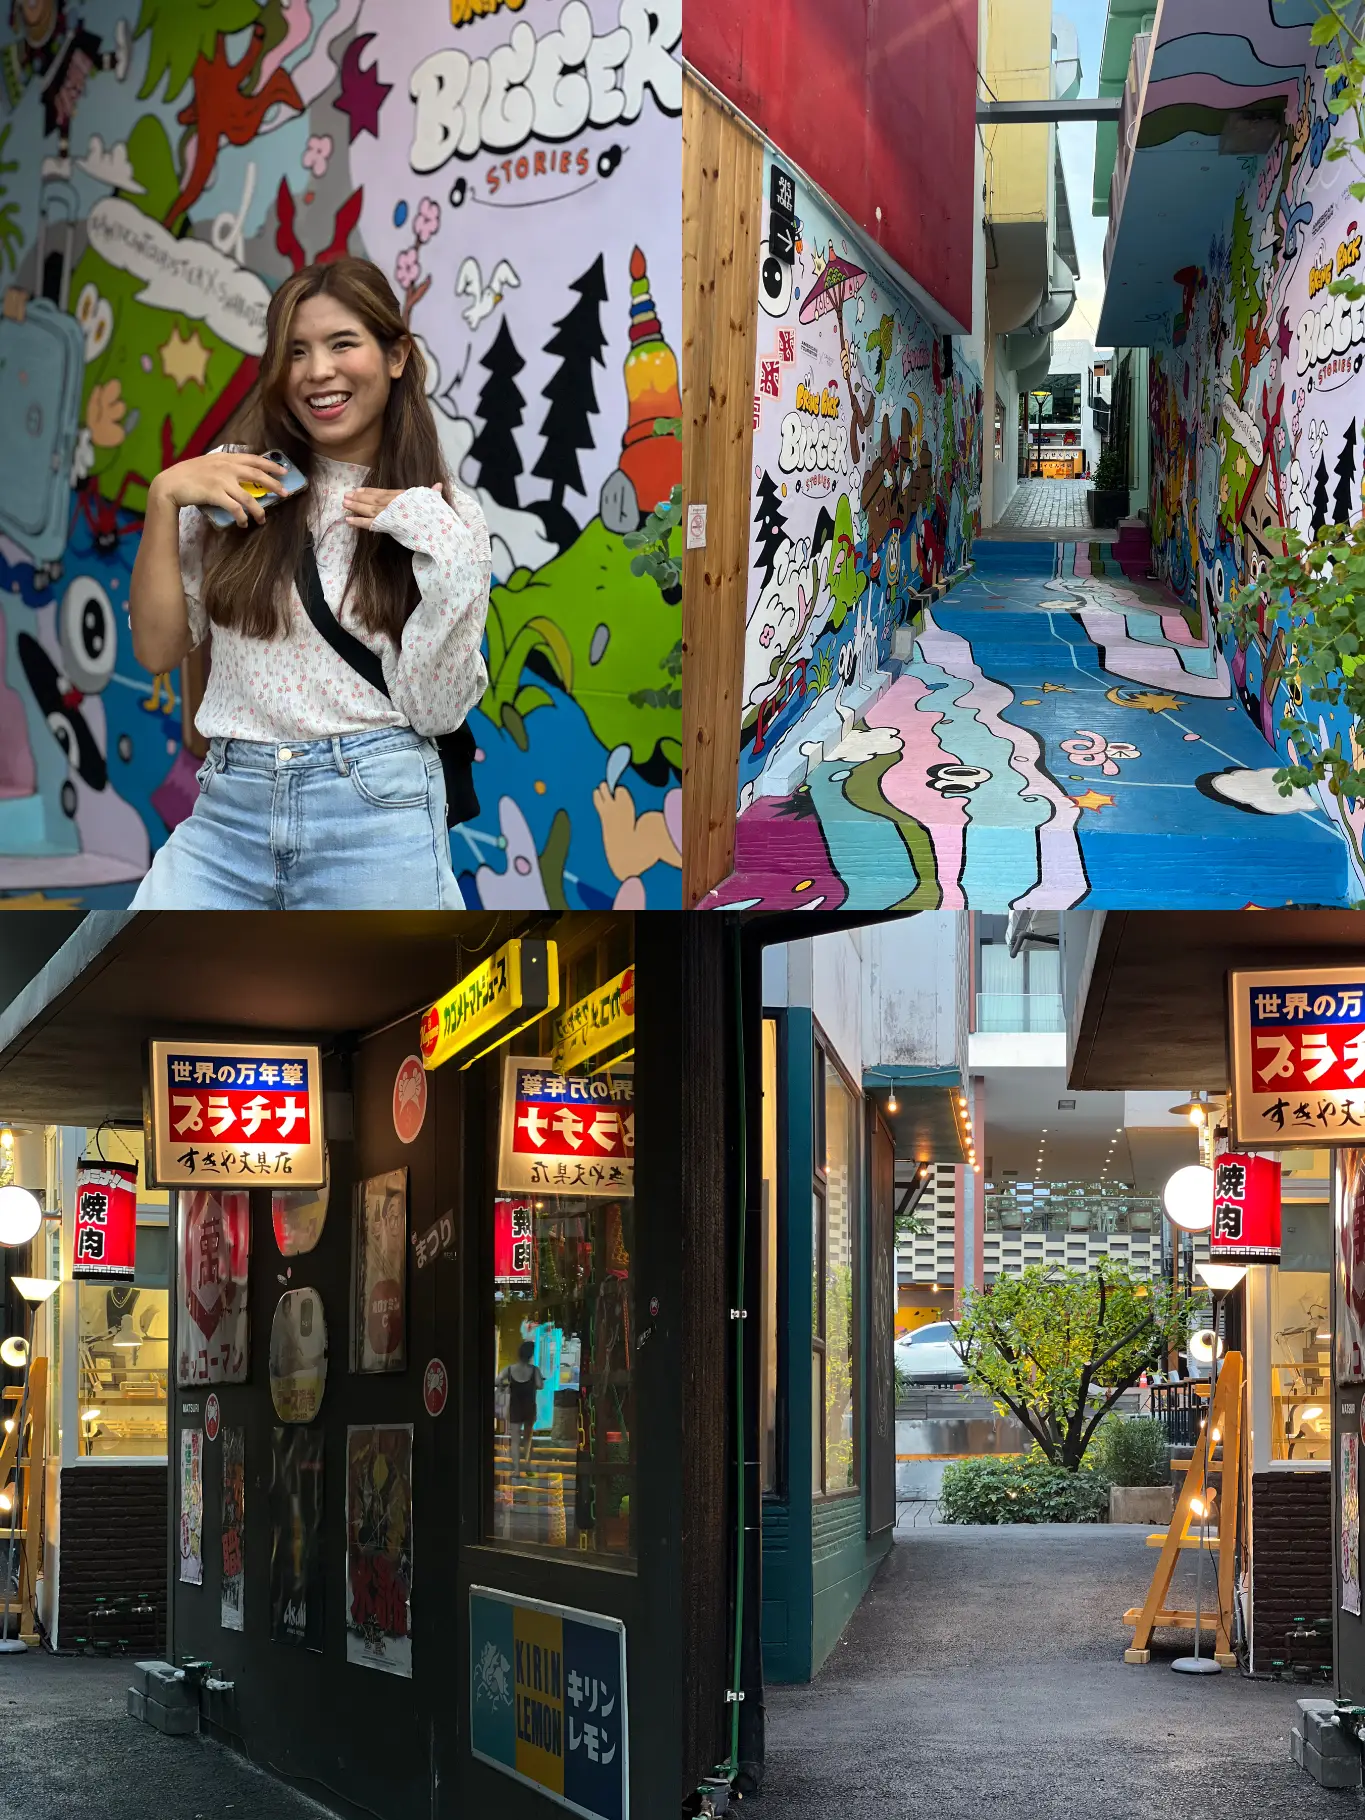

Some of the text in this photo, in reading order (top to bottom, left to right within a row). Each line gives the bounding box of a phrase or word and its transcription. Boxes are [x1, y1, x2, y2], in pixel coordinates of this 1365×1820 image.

[409, 0, 682, 174] BIGGER
[486, 147, 590, 195] STORIES
[776, 194, 793, 212] TOILET
[1308, 234, 1363, 299] BRING BACK
[1317, 356, 1351, 385] STORIES
[796, 382, 840, 420] BRING BACK
[778, 411, 848, 476] BIGGER
[805, 473, 831, 491] STORIES
[171, 1061, 304, 1086] 世界の万年筆
[172, 1094, 306, 1138] プラチナ
[1213, 1162, 1246, 1240] 焼肉
[77, 1191, 109, 1260] 焼肉
[415, 1218, 453, 1269] まつり
[381, 1314, 389, 1328] C
[180, 1343, 244, 1381] キッコーマン
[182, 1403, 200, 1414] MATSURI
[516, 1638, 561, 1698] KIRIN
[567, 1669, 614, 1718] キリン
[517, 1693, 562, 1758] LEMON
[569, 1716, 616, 1765] レモン
